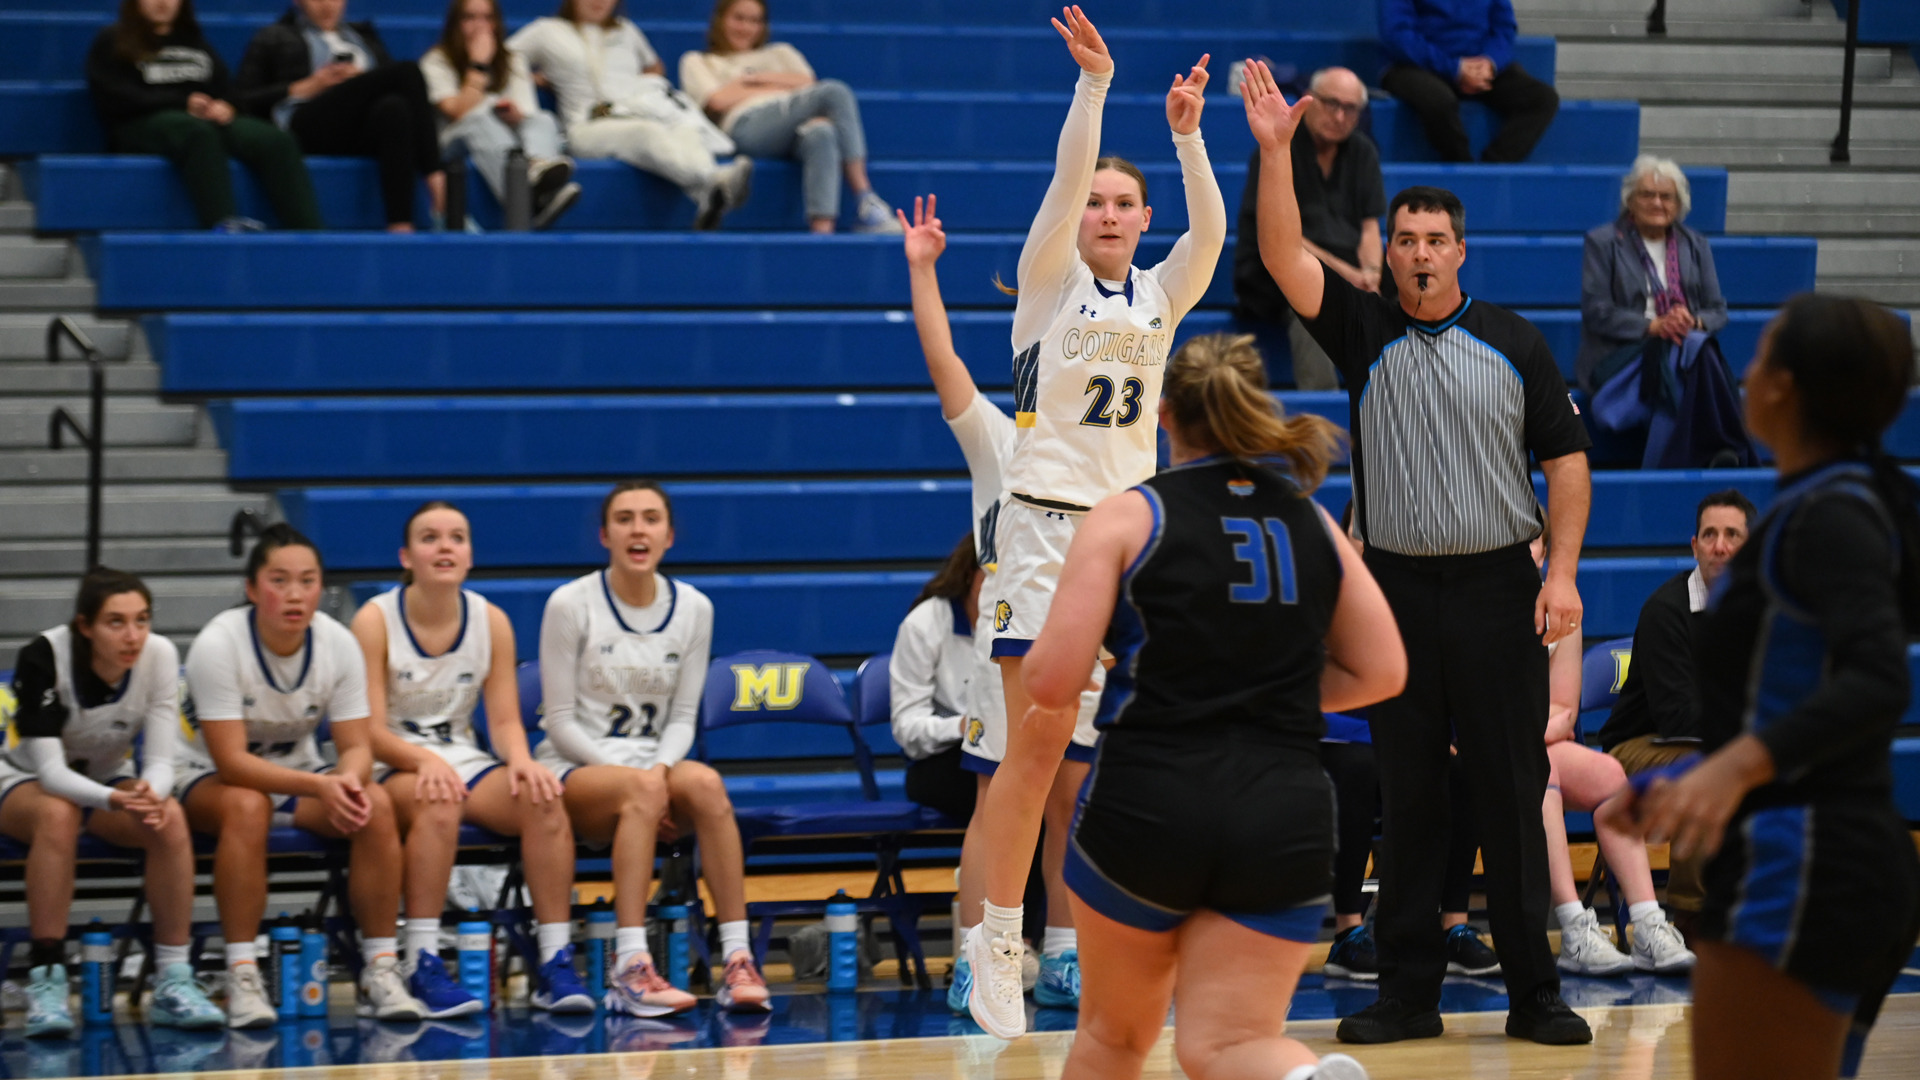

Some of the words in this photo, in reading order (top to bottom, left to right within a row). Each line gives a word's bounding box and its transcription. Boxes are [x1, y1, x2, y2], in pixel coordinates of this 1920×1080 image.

[1062, 327, 1165, 366] COUGARS
[1079, 374, 1145, 428] 23
[1220, 516, 1299, 605] 31
[730, 661, 811, 711] MU
